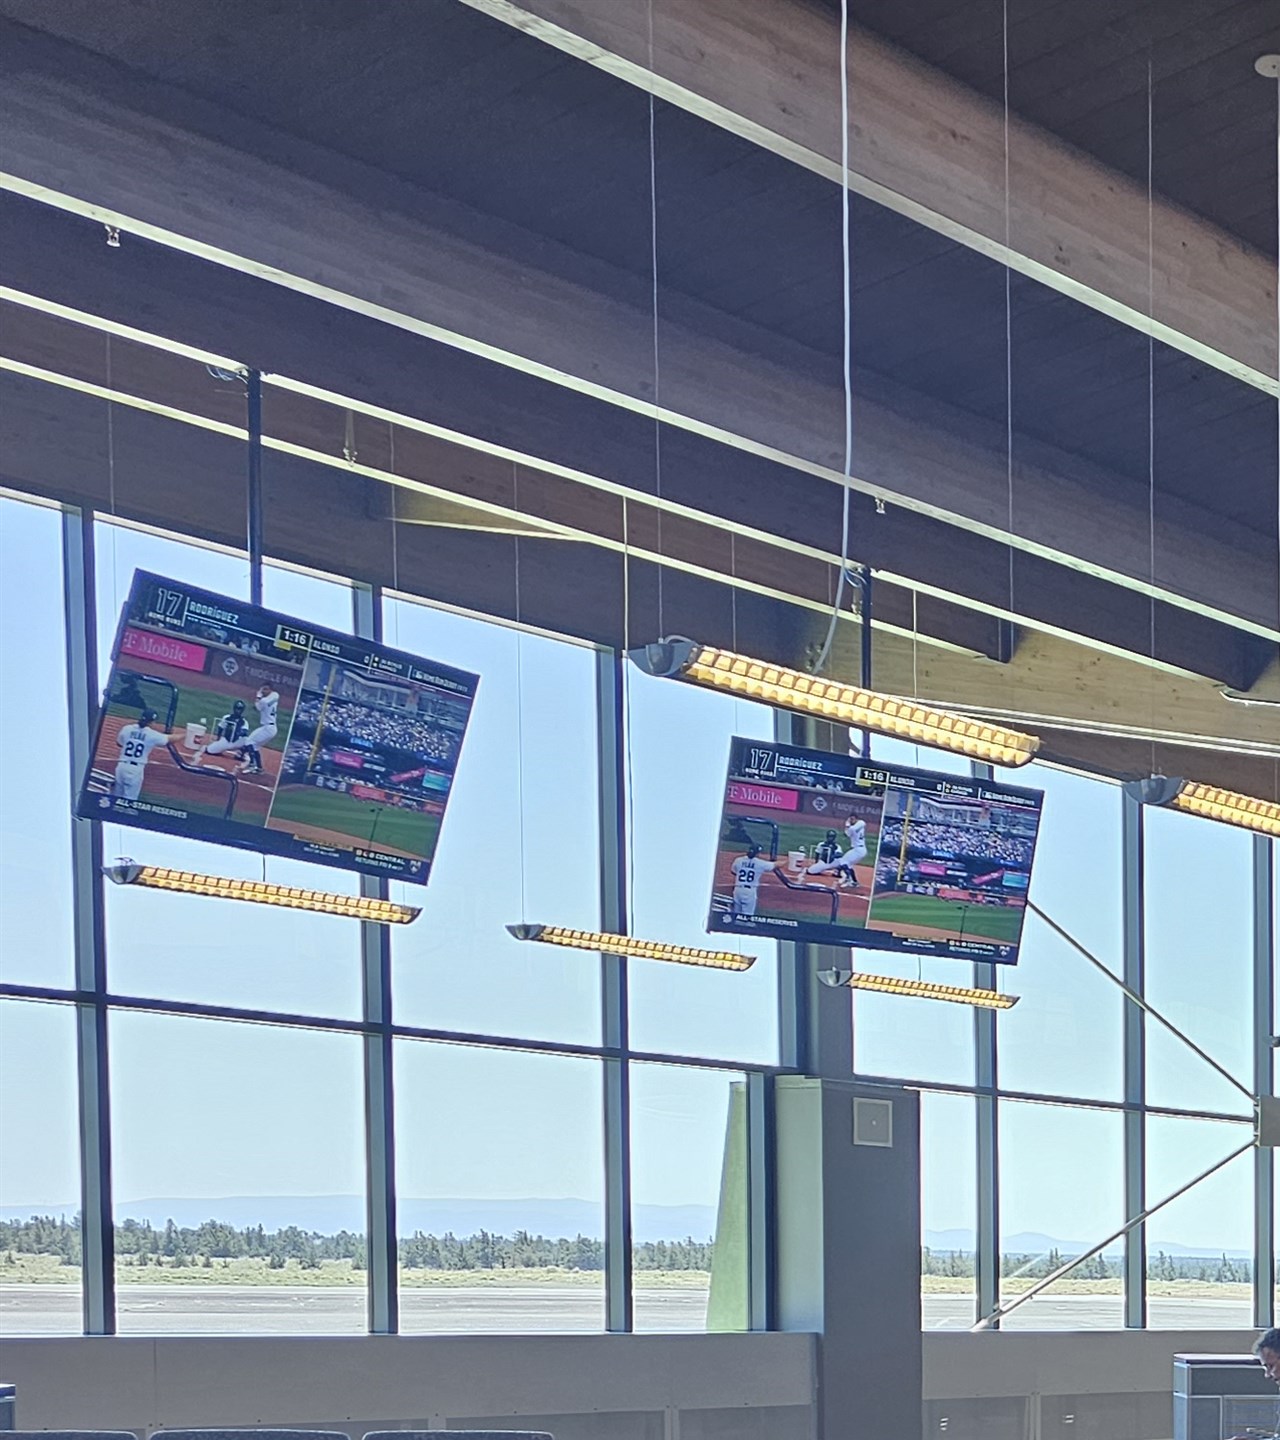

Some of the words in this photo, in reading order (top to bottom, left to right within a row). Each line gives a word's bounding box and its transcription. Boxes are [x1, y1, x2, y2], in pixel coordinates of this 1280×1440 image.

[156, 587, 183, 616] 17
[284, 630, 307, 645] 1:16
[124, 741, 145, 758] 28
[750, 748, 773, 770] 17
[863, 770, 885, 782] 1:16
[740, 785, 782, 804] Mobile
[737, 870, 755, 883] 28
